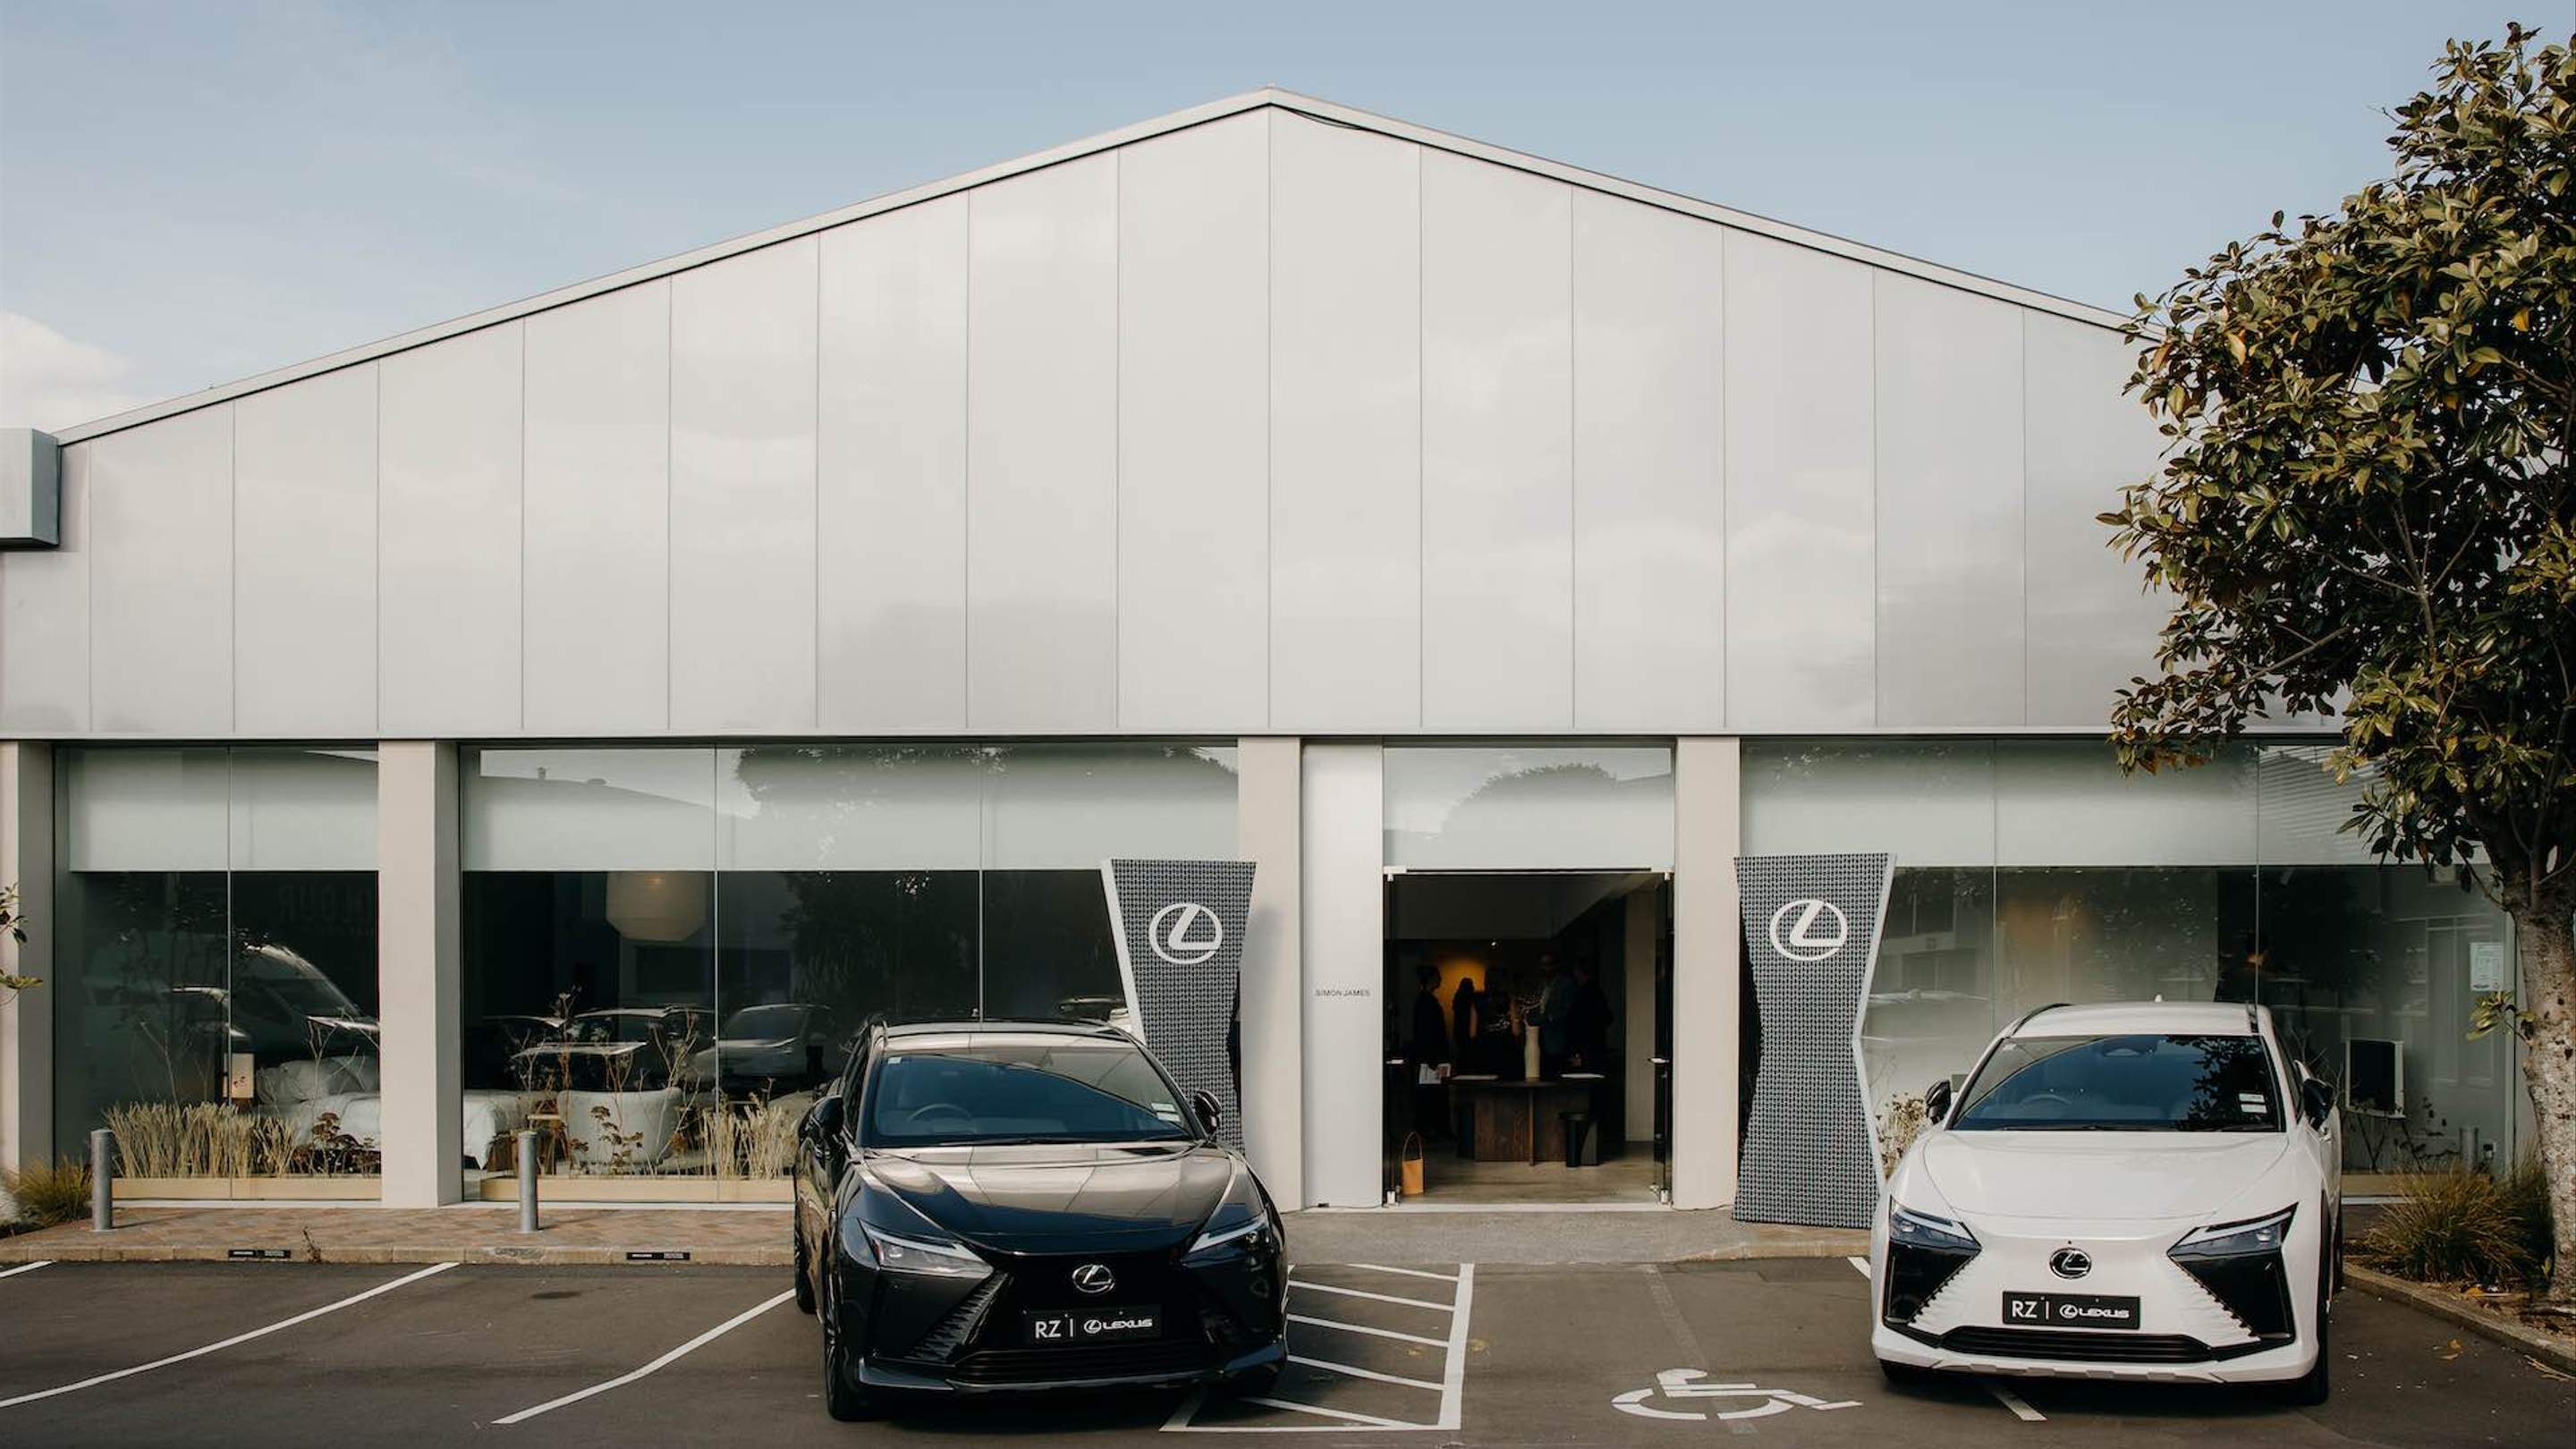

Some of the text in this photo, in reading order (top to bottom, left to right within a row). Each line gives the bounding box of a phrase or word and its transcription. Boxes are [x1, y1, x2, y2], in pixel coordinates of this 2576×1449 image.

[2012, 1300, 2038, 1318] RZ
[2079, 1308, 2130, 1318] LEXUS
[1035, 1319, 1062, 1339] RZ
[1103, 1318, 1153, 1329] LEXUS
